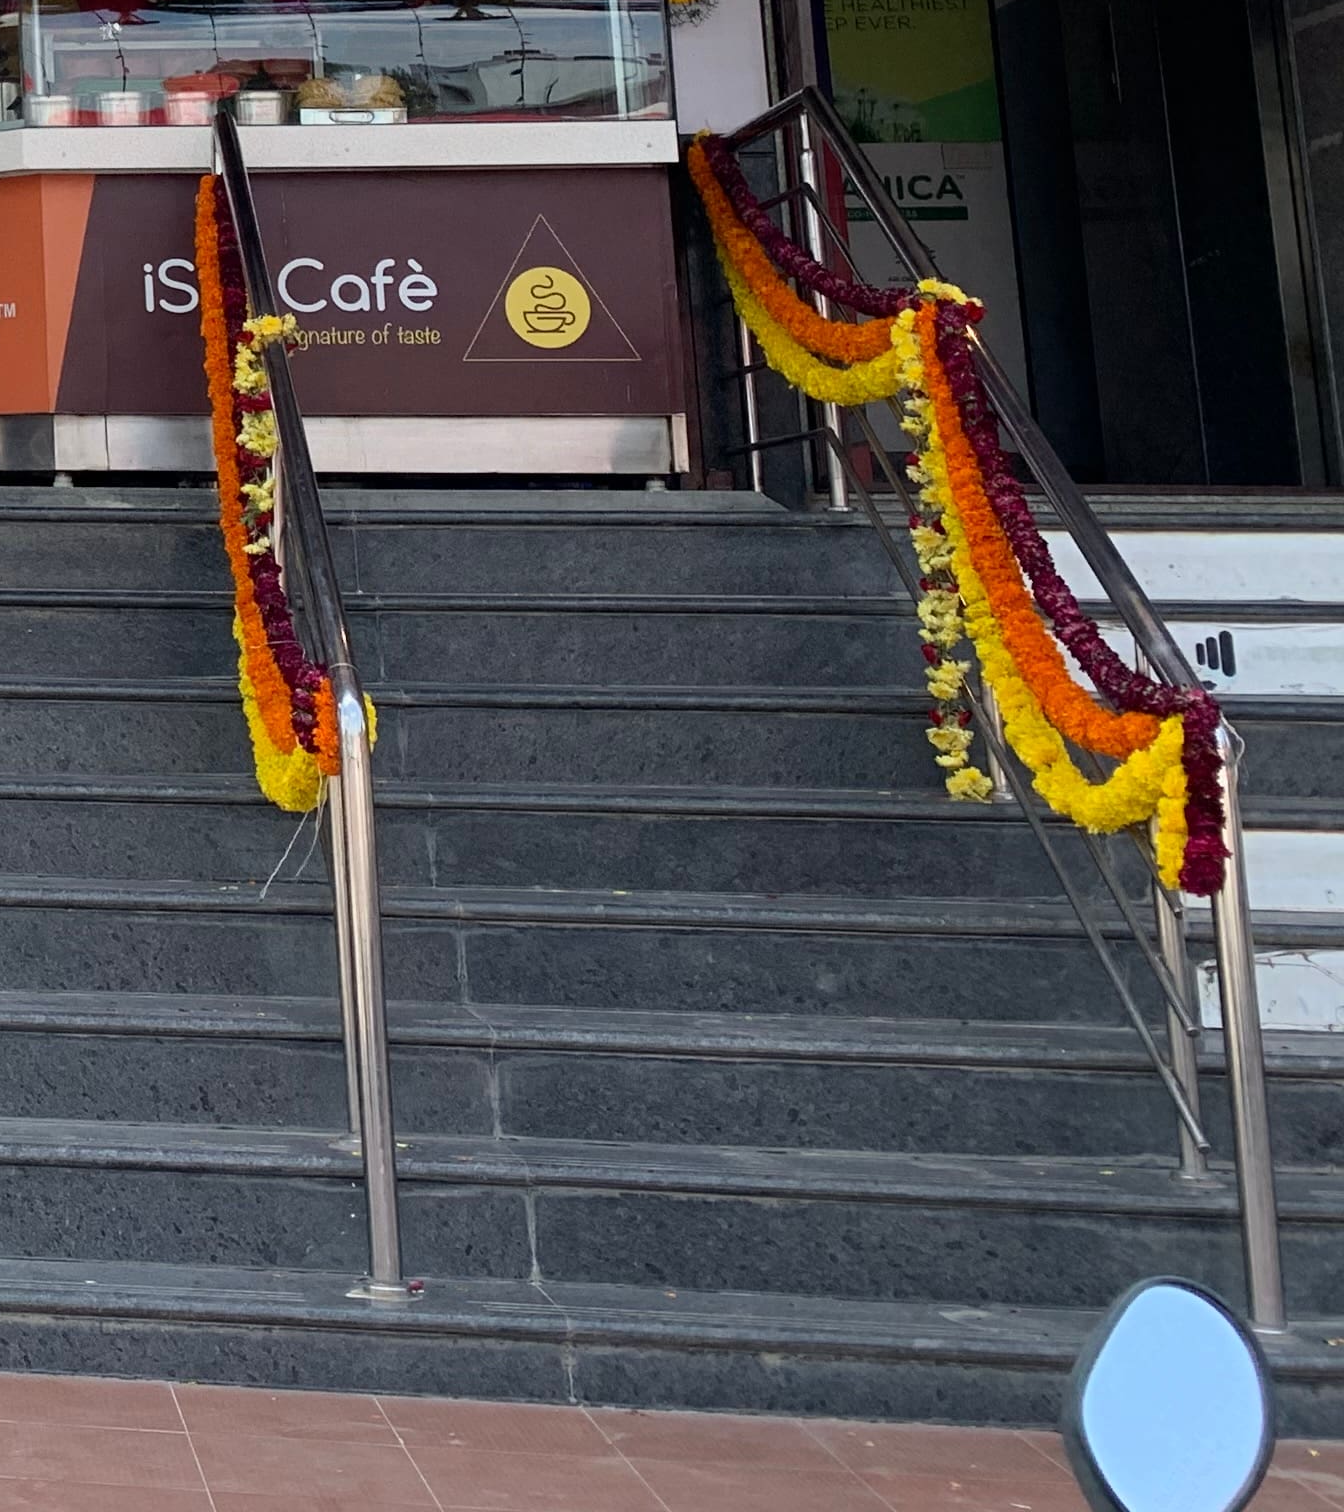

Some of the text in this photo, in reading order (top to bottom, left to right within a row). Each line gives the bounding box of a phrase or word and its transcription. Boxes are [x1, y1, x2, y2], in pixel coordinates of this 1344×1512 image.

[855, 15, 917, 31] EVER.
[276, 257, 439, 313] Cafè
[371, 321, 394, 346] of
[397, 325, 442, 346] taste
